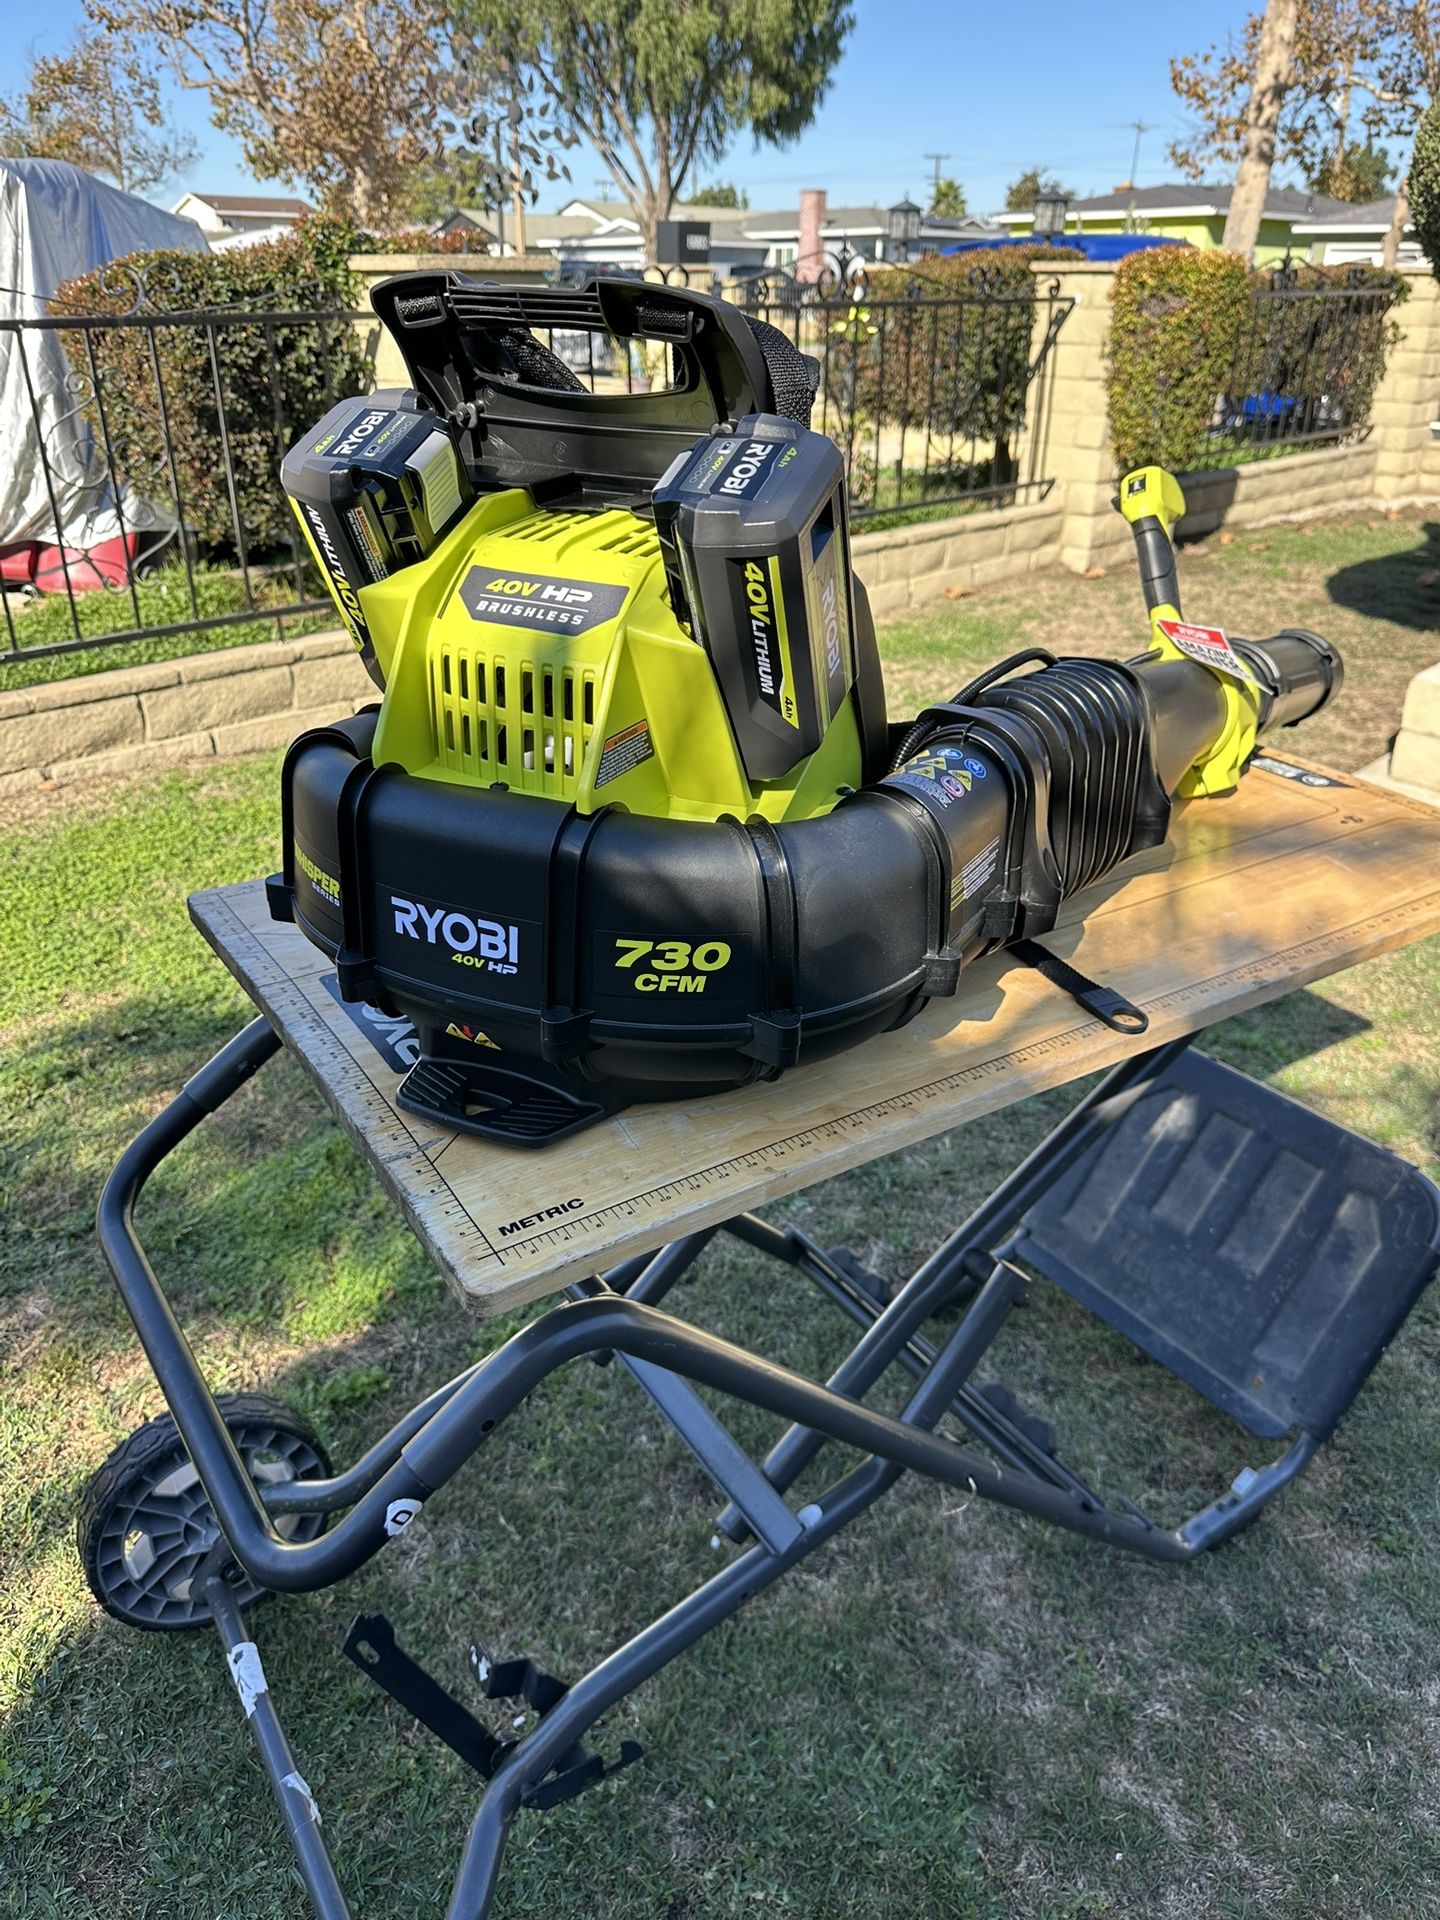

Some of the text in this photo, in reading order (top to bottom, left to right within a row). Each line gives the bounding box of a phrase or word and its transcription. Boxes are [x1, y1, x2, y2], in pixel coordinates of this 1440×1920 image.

[314, 434, 335, 454] 4Ah
[332, 411, 389, 455] RYOBI
[720, 443, 774, 495] RYOBI
[779, 447, 797, 468] 4Ah
[485, 578, 593, 604] 40V HP
[475, 600, 585, 626] BRUSHLESS
[744, 561, 776, 696] 40V LITHIUM
[821, 578, 841, 679] RYOBI
[784, 695, 794, 719] 4Ah
[391, 895, 519, 964] RYOBI
[451, 953, 519, 976] 40V HP
[614, 938, 732, 972] 730
[634, 973, 707, 993] CFM
[498, 1198, 585, 1237] METRIC
